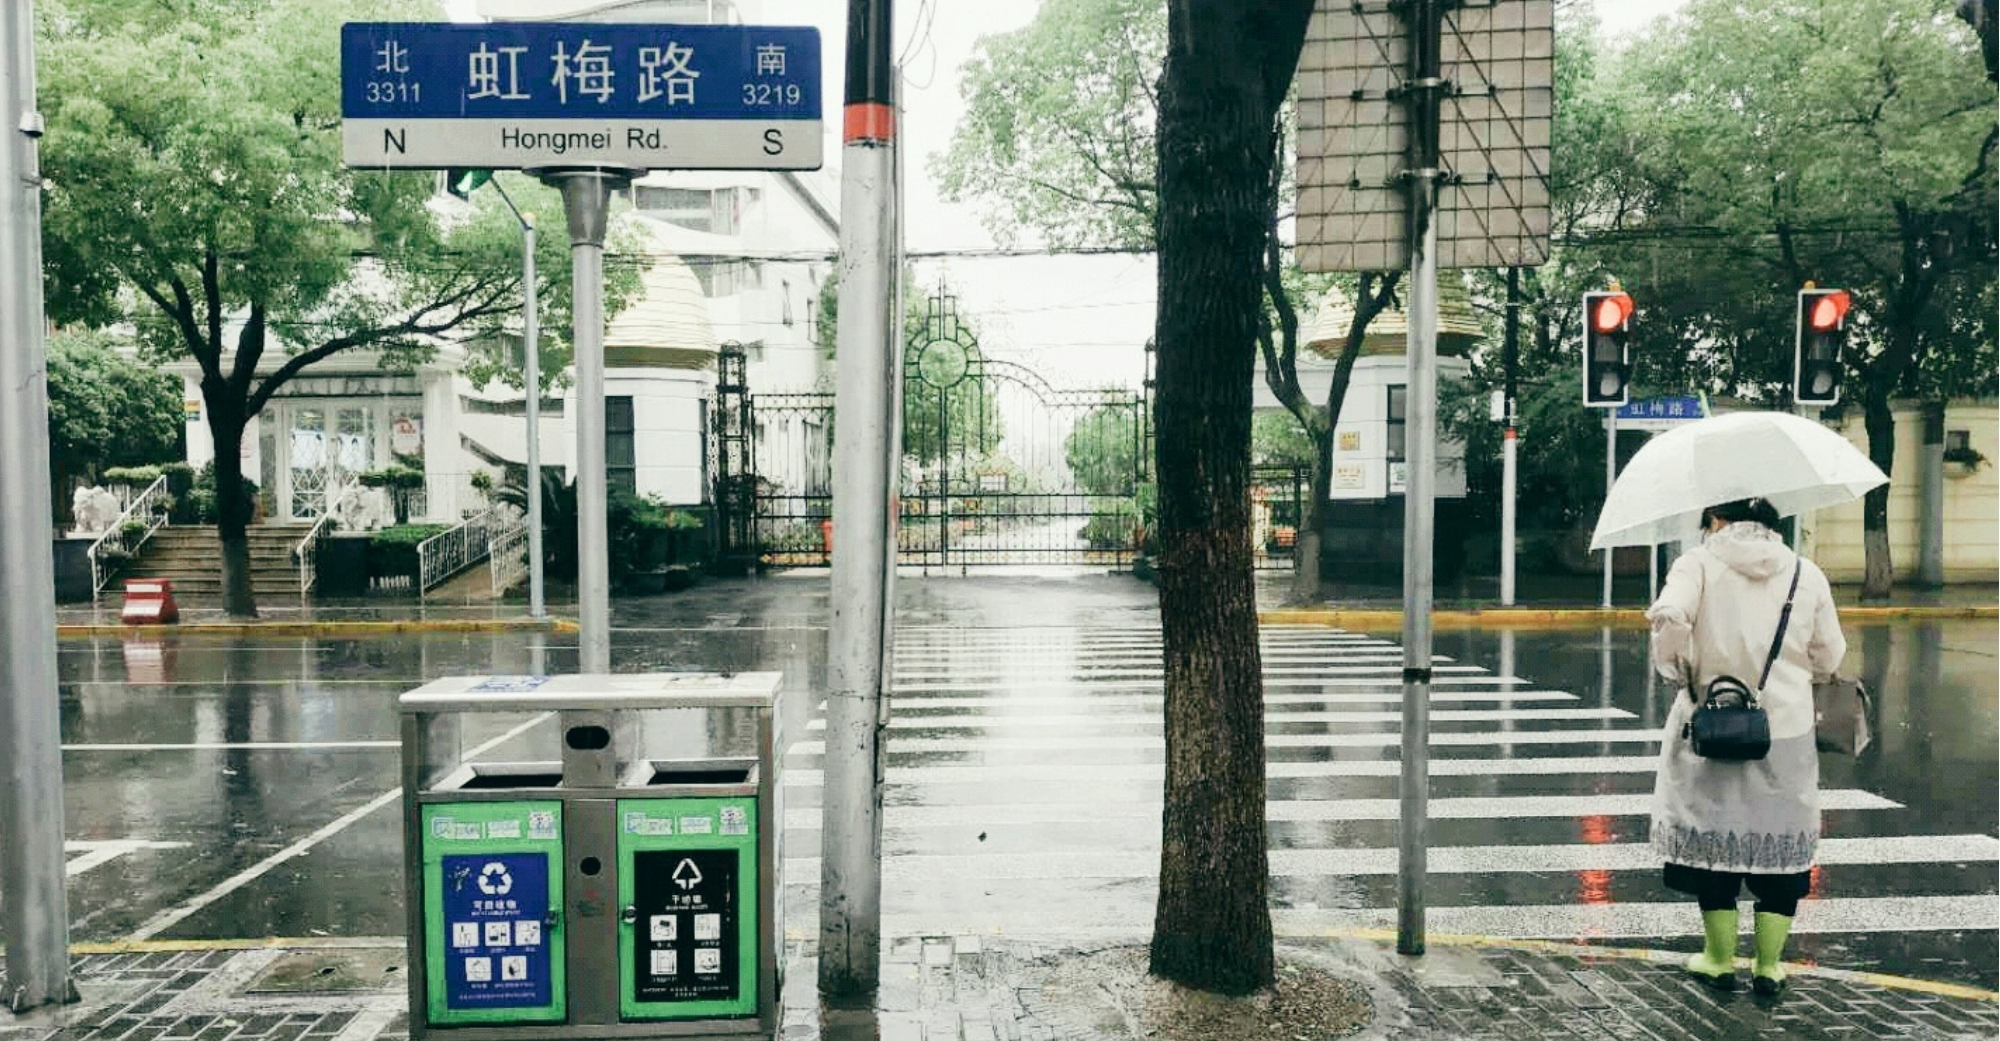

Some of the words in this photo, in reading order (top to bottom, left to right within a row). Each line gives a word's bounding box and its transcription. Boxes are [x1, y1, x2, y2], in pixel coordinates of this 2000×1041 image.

[377, 42, 410, 73] 北
[756, 44, 786, 76] 南
[467, 39, 700, 105] 虹梅路
[366, 82, 421, 103] 3311
[742, 84, 801, 105] 3219
[384, 128, 406, 154] N
[501, 127, 612, 155] Hongmei
[626, 128, 669, 150] Rd.
[762, 128, 785, 156] S
